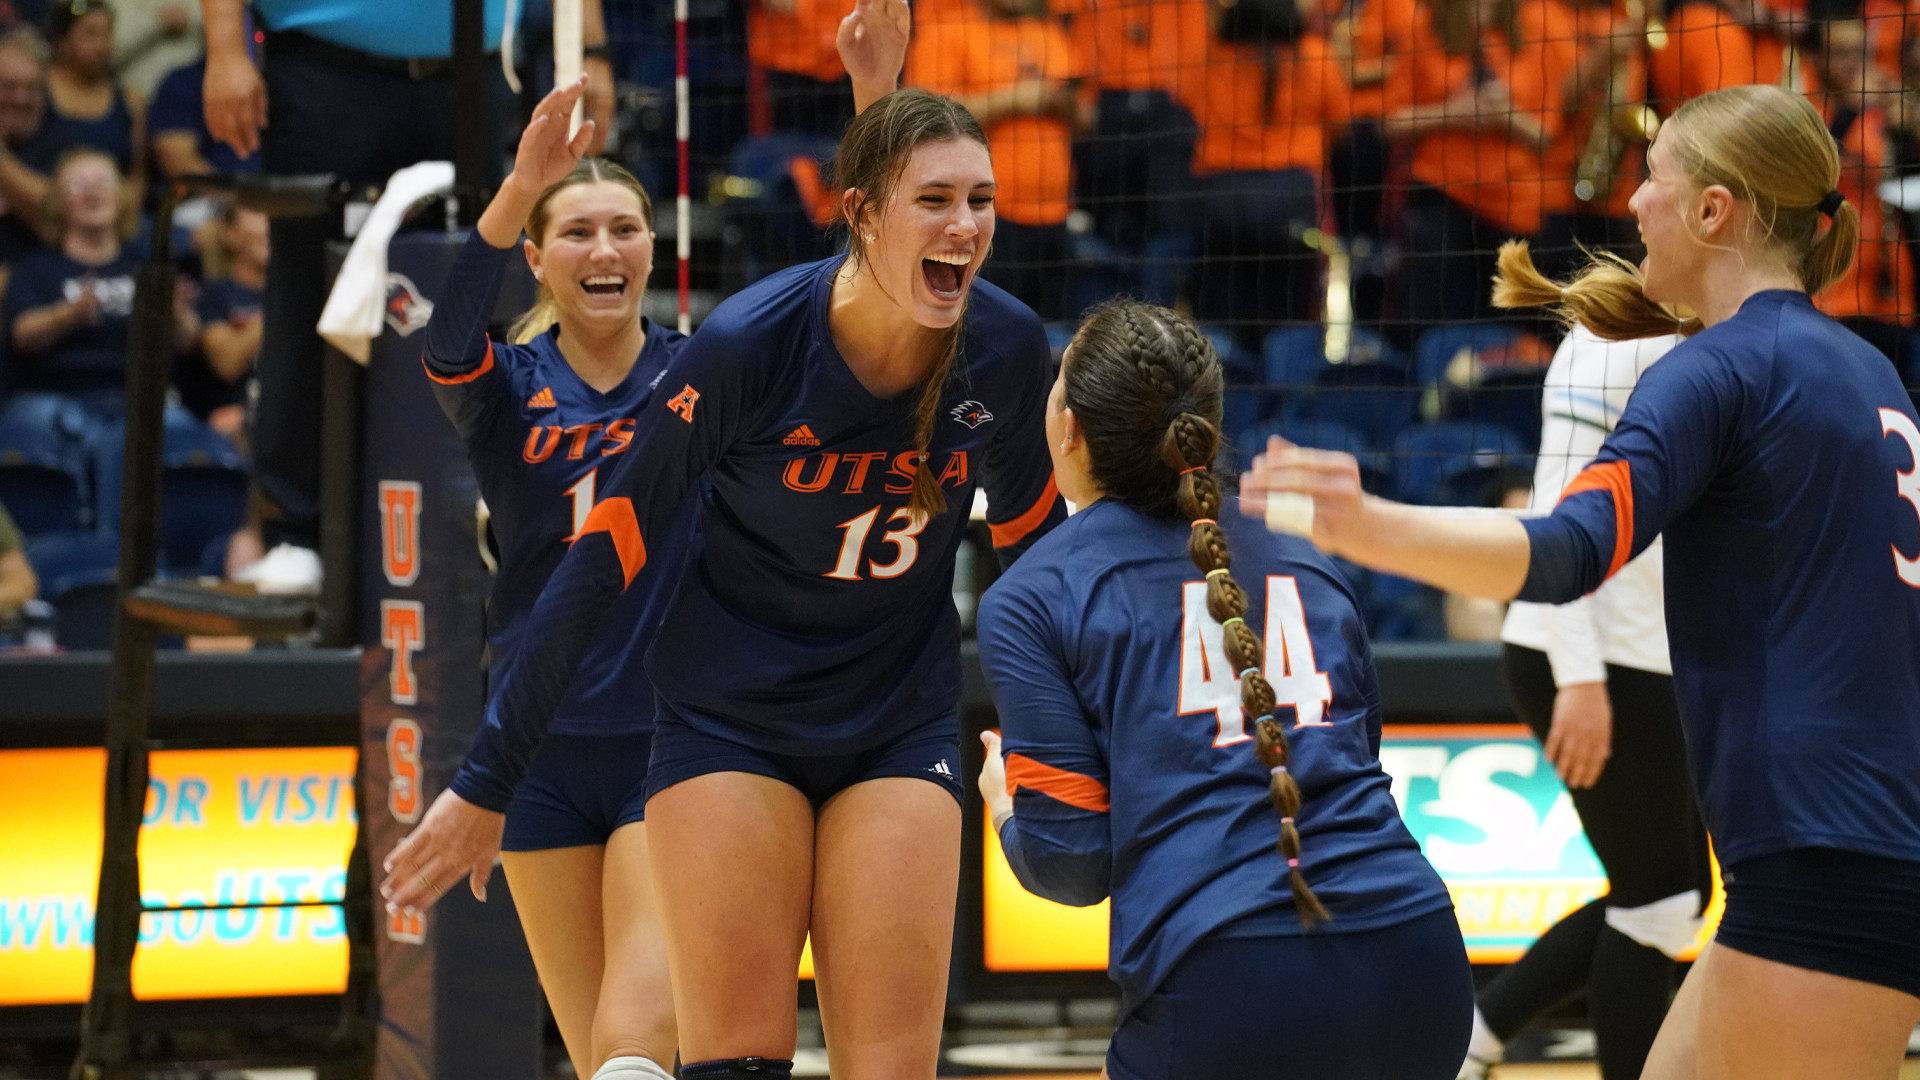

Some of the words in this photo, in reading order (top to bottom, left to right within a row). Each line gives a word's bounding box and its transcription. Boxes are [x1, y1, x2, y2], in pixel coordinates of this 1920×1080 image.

[522, 418, 637, 464] UTS
[783, 436, 821, 447] adidas
[782, 450, 968, 495] UTSA
[821, 504, 931, 581] 13
[1177, 574, 1334, 748] 44
[143, 777, 207, 824] OR
[240, 777, 359, 823] VISI
